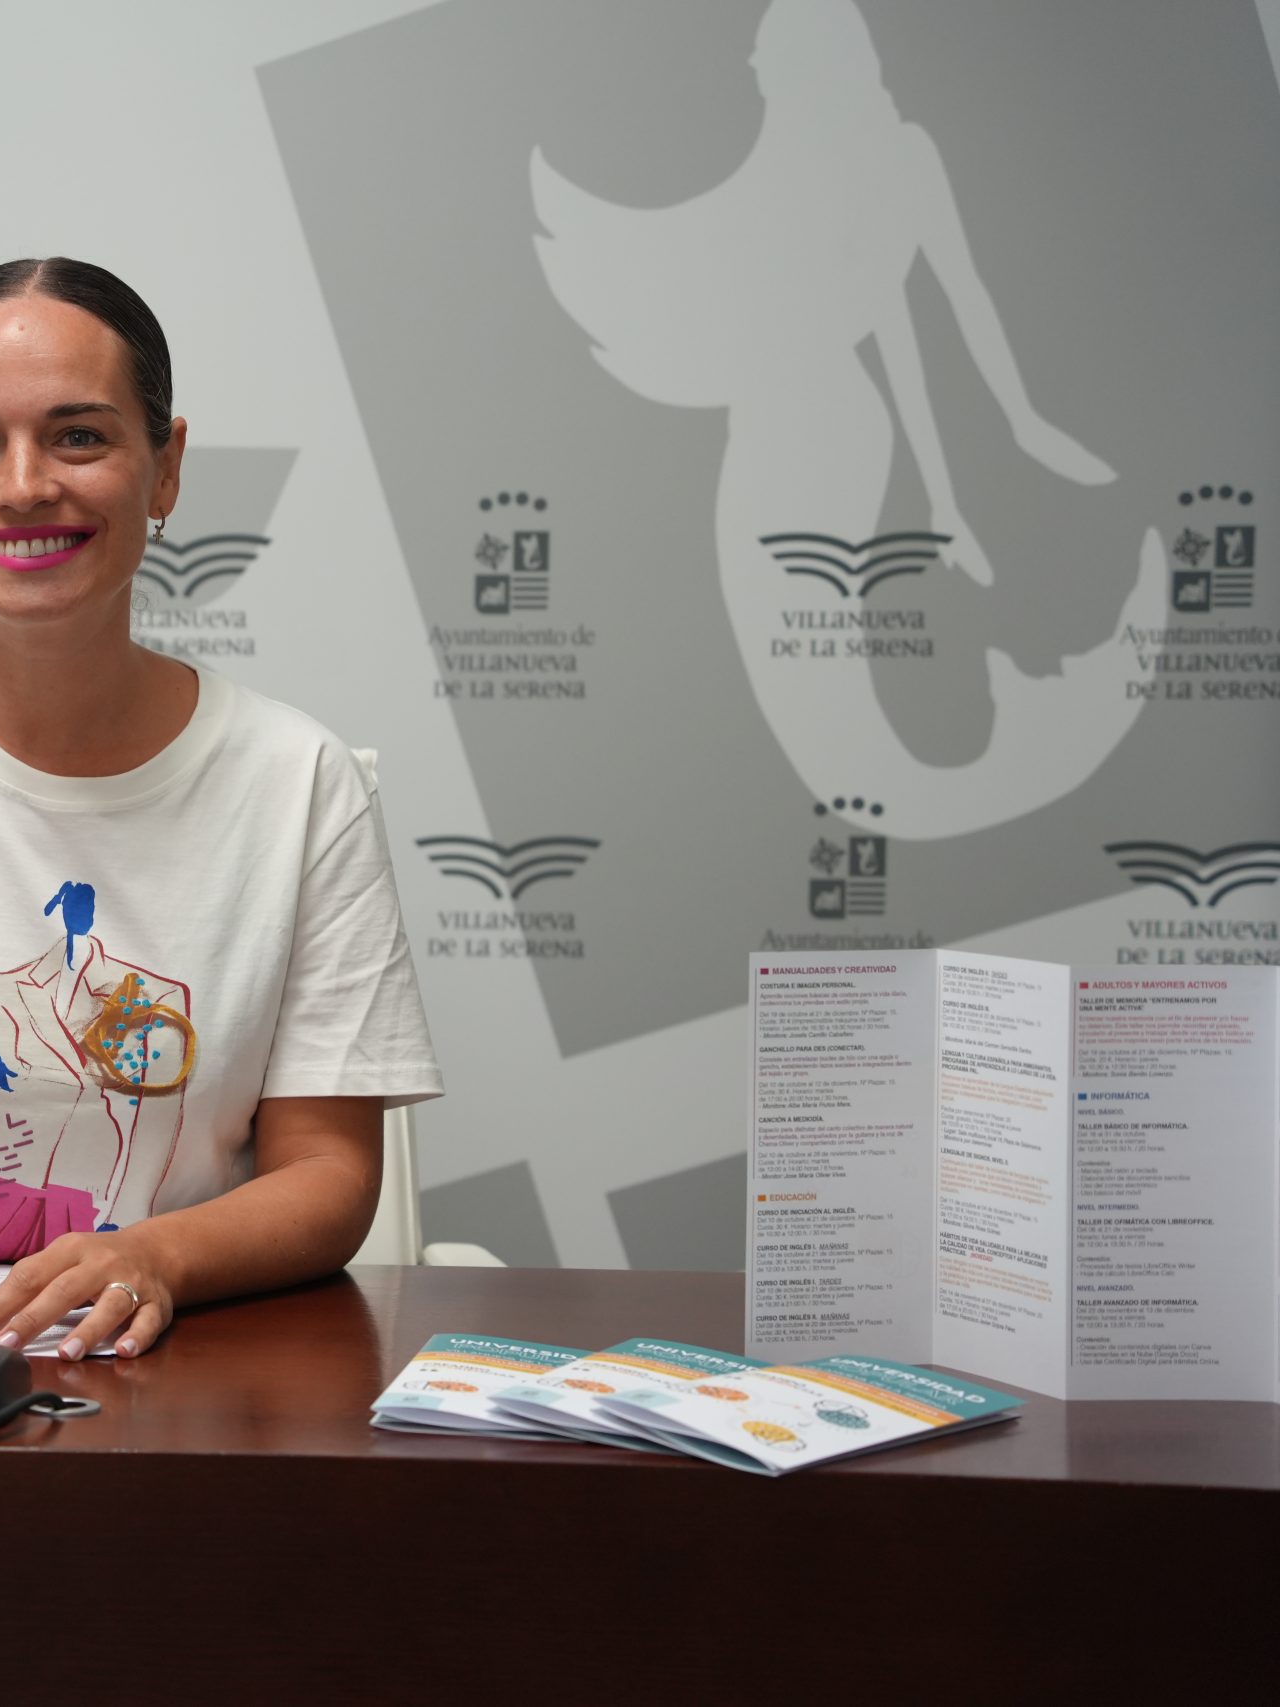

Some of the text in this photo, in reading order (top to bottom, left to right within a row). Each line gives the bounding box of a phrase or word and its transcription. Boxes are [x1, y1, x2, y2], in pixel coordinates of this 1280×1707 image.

[430, 624, 596, 652] Ayuntamiento de
[1120, 624, 1272, 651] Ayuntamiento
[772, 967, 836, 975] MANUALIDADES
[844, 966, 897, 974] CREATIVIDAD
[1090, 1092, 1150, 1100] INFORMÁTICA
[829, 1357, 986, 1404] UNIVERSIDAD
